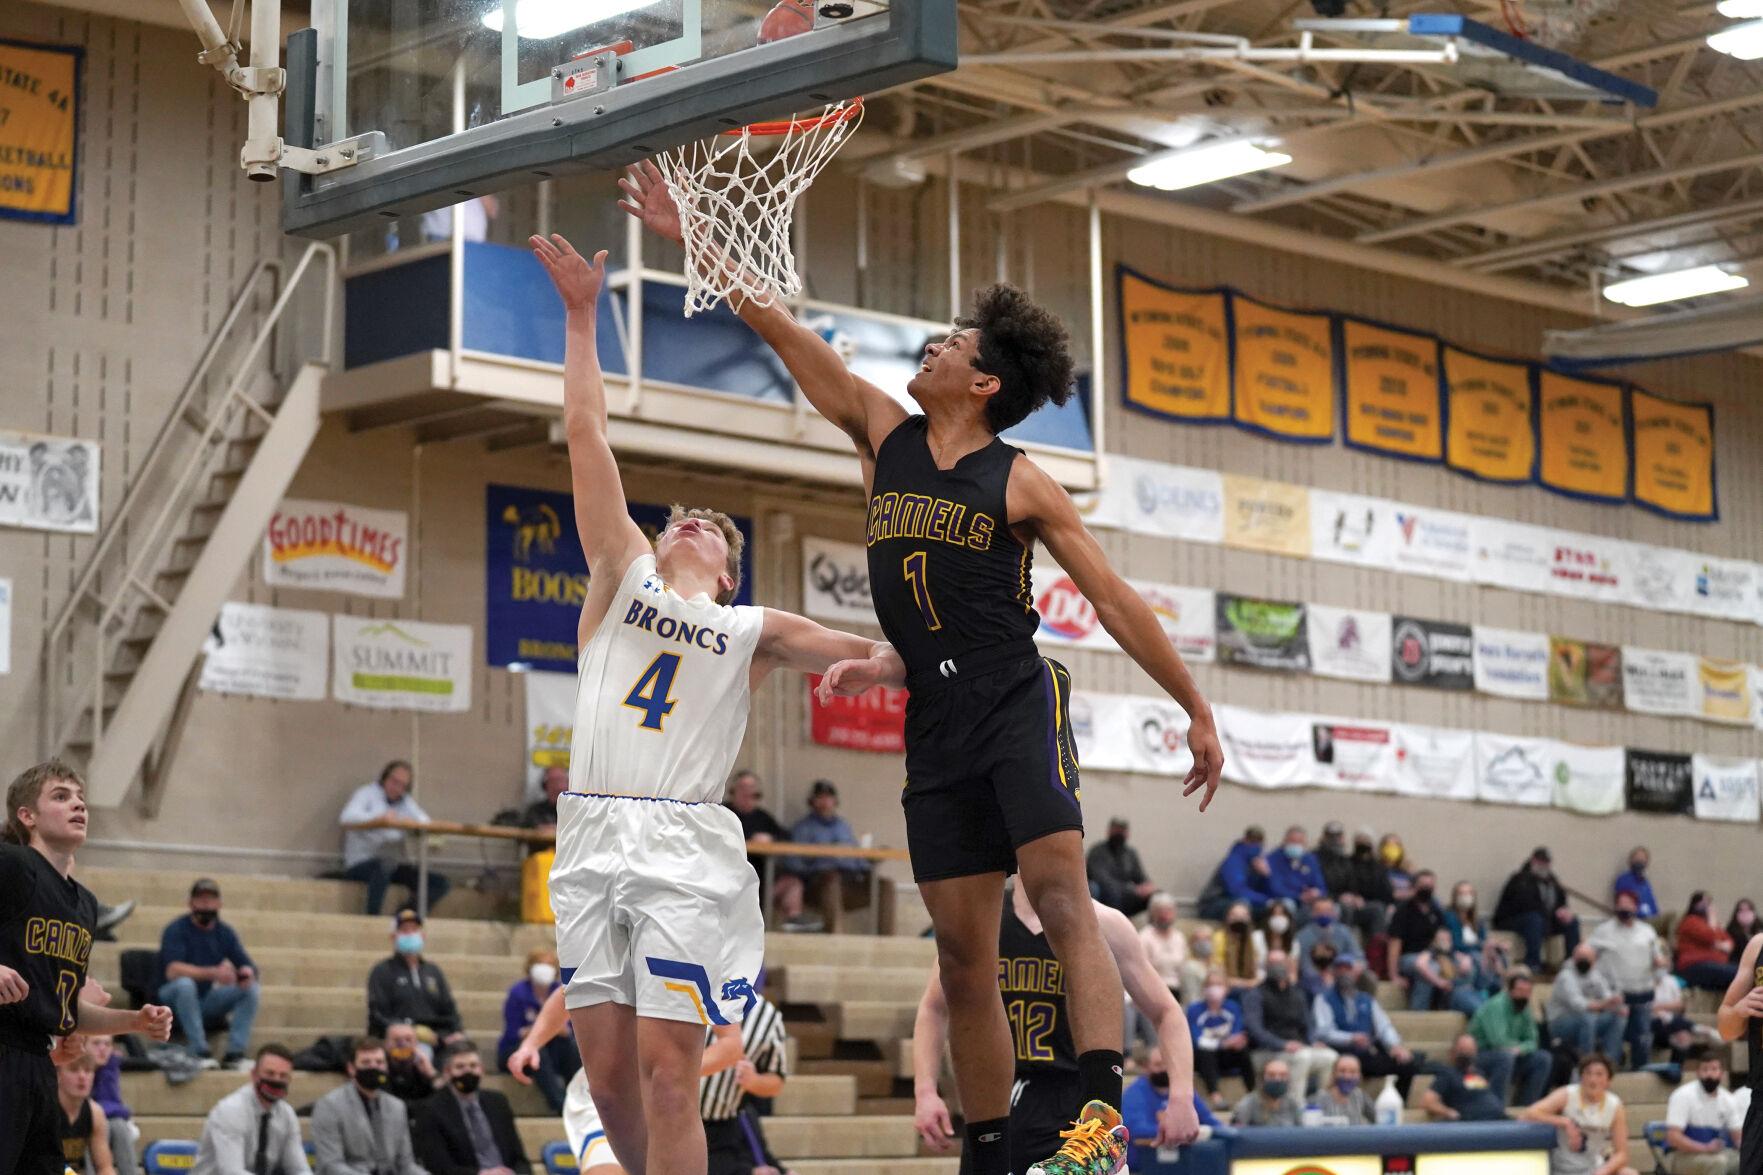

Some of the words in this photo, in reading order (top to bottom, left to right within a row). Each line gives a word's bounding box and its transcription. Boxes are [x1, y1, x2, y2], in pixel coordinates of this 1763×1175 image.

[0, 65, 42, 95] TATE
[867, 492, 995, 550] CAMELS
[903, 551, 942, 631] 1
[623, 598, 729, 655] BRONCS
[352, 645, 454, 676] SUMMIT
[620, 650, 683, 733] 4
[1008, 999, 1056, 1061] 12
